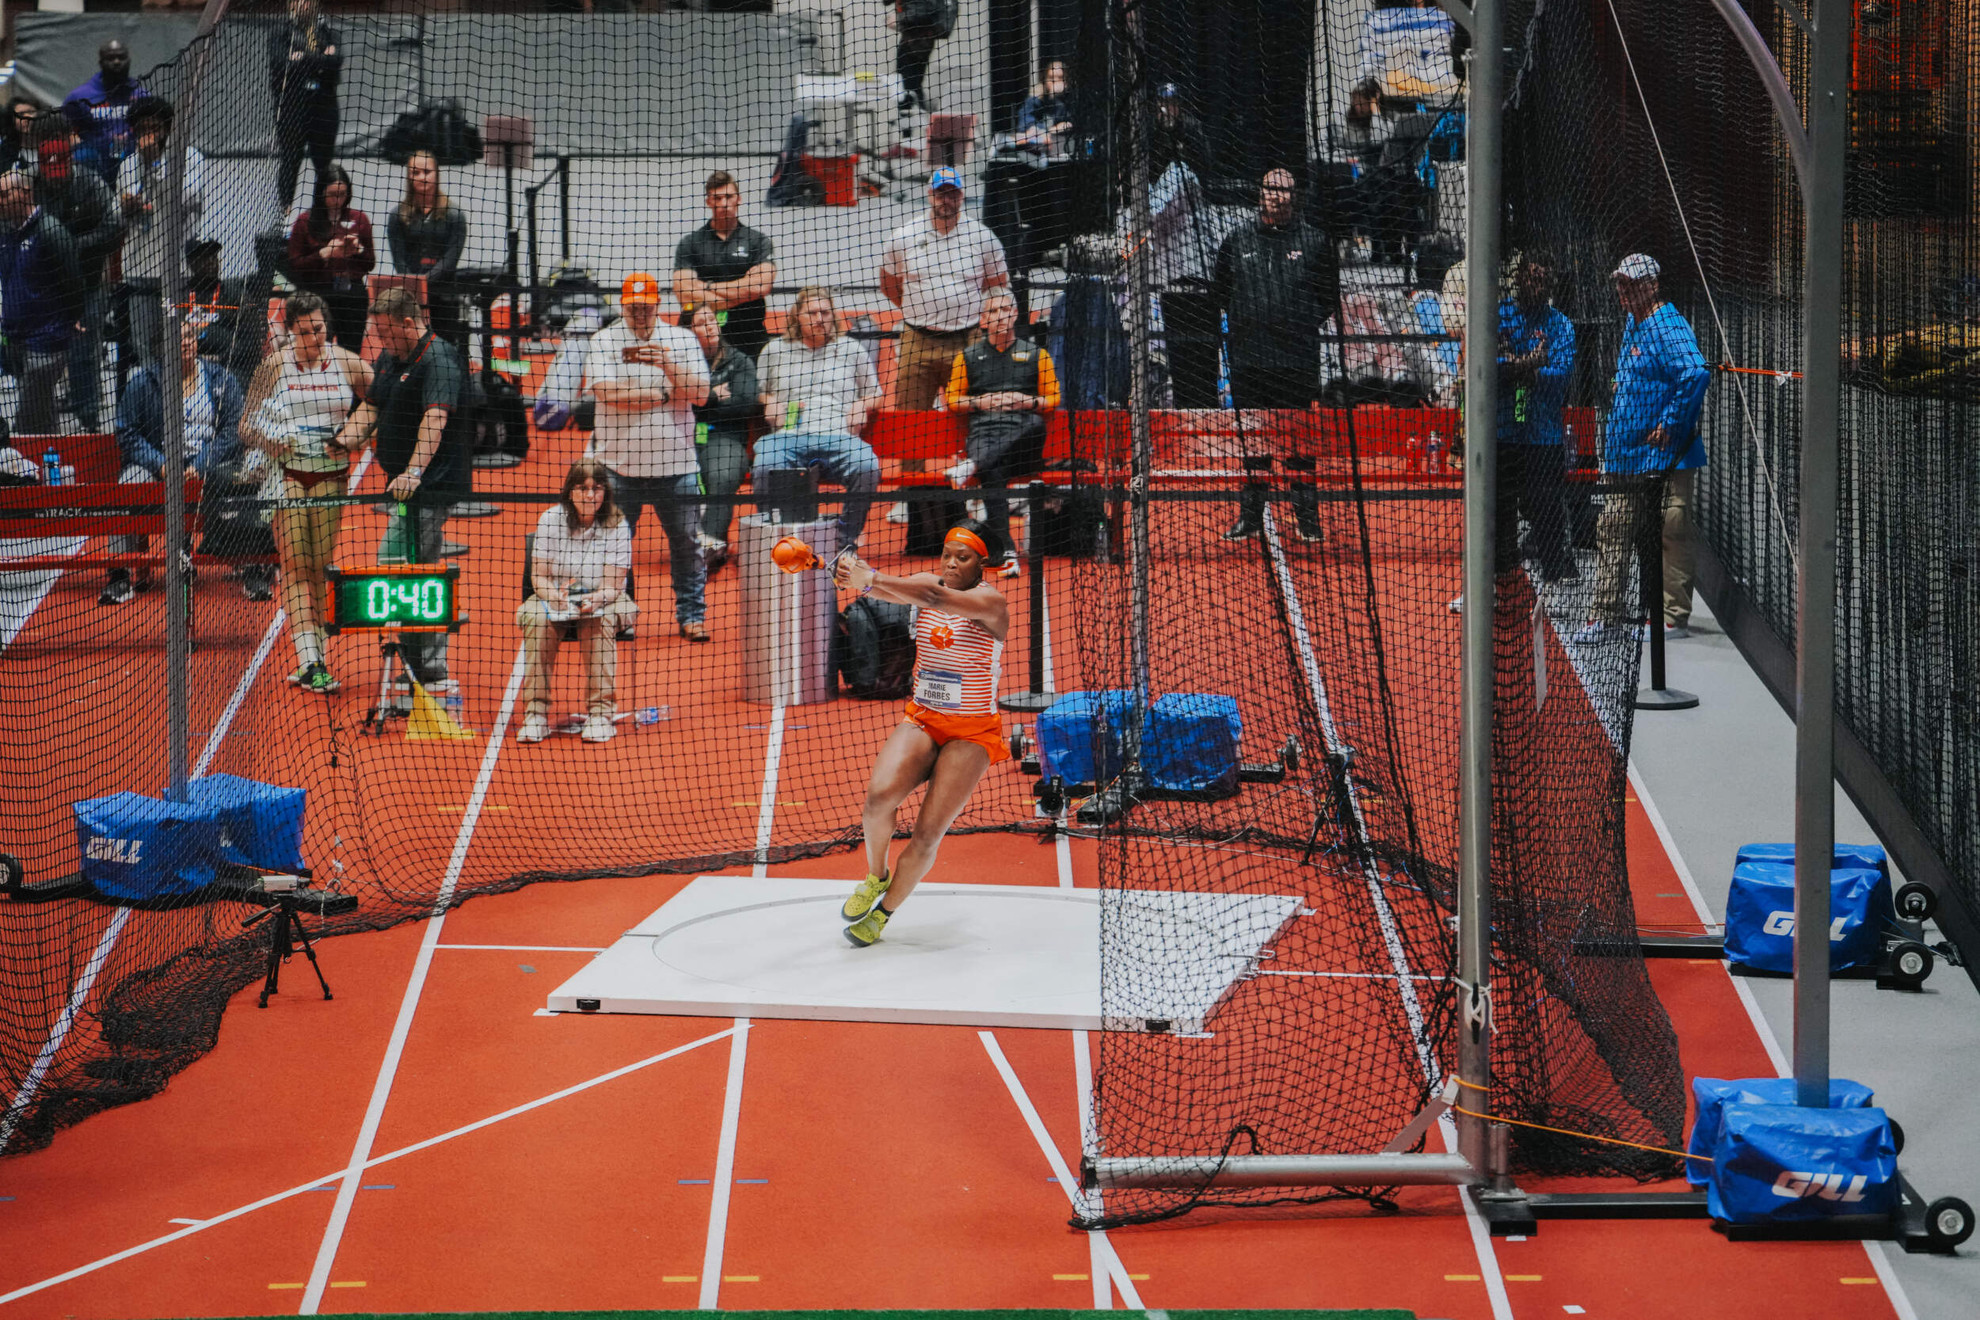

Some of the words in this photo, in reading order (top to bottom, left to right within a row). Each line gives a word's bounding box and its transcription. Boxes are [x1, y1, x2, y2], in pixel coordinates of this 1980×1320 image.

[368, 580, 443, 619] 0:40
[924, 689, 951, 701] FORBES
[928, 682, 947, 691] MARIE
[86, 836, 143, 864] GILL
[1763, 910, 1847, 941] GL
[1772, 1170, 1868, 1203] GILL
